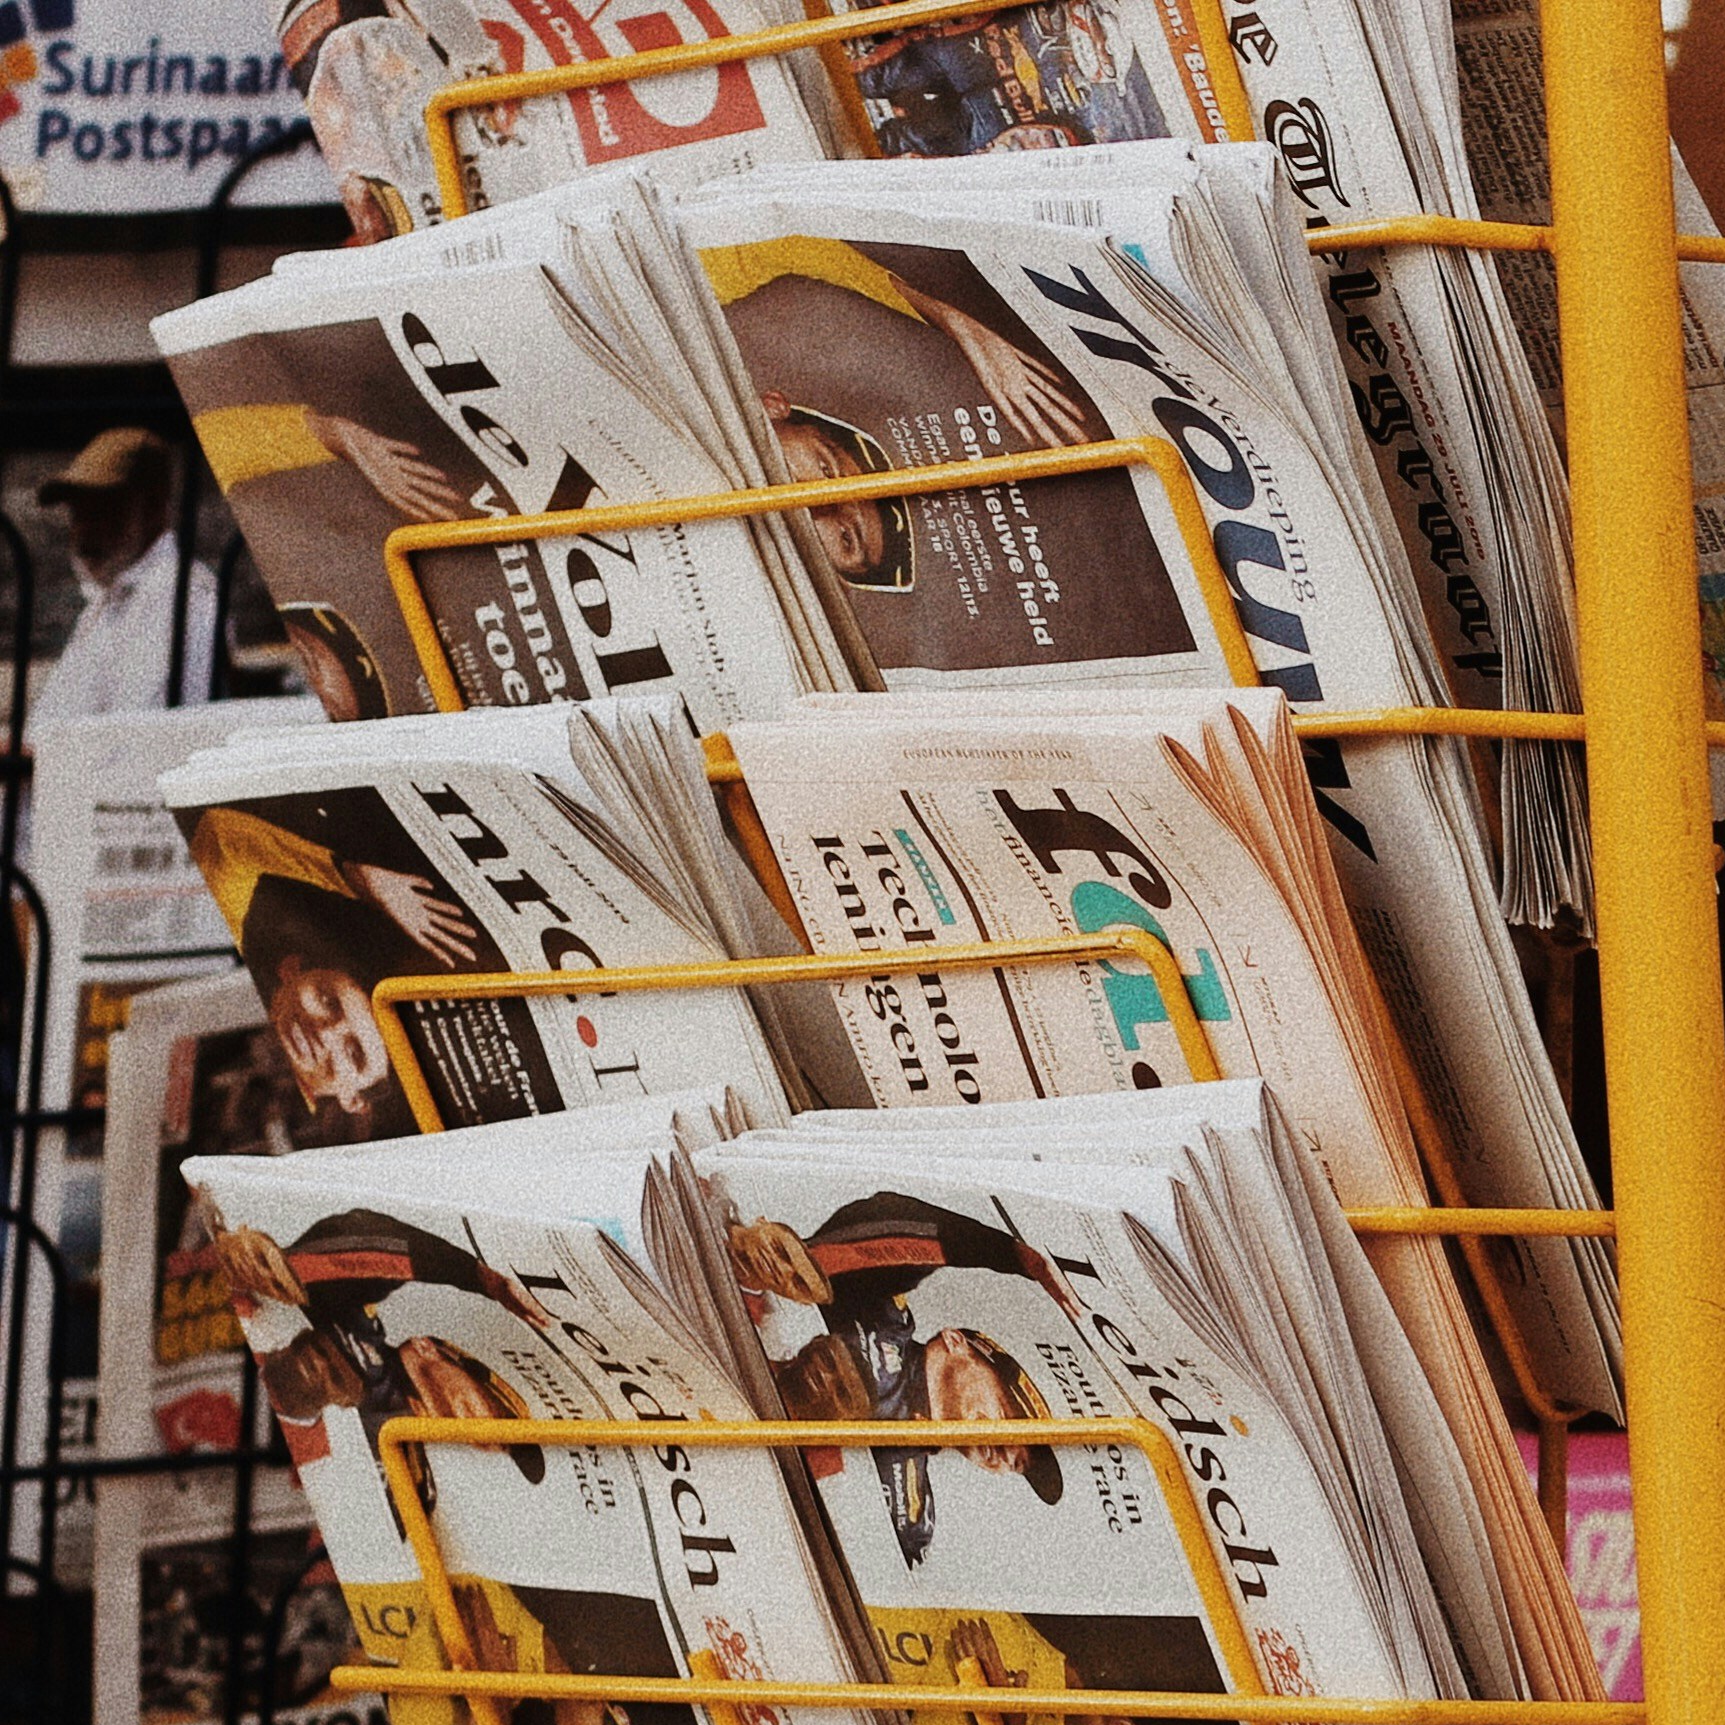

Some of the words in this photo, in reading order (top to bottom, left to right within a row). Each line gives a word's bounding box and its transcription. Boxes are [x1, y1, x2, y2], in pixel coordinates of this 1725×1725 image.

[896, 415, 923, 467] VANDA
[913, 414, 942, 468] winna
[950, 511, 989, 593] Colombia
[975, 402, 1003, 446] De
[994, 451, 1034, 526] our
[1019, 521, 1062, 605] heeft
[1385, 320, 1437, 431] MAANDAG
[1440, 459, 1468, 511] JULI
[543, 443, 674, 695] Vol
[951, 406, 984, 463] een
[980, 485, 1025, 575] ieuwe
[1013, 578, 1054, 649] held
[965, 517, 994, 573] eerste
[460, 1001, 501, 1085] pektakel
[489, 999, 511, 1035] our
[1084, 986, 1131, 1093] dagbla
[501, 1349, 562, 1421] bizarr
[1034, 1341, 1098, 1453] bizare
[1091, 1463, 1125, 1535] race
[1045, 1246, 1280, 1603] Leidsch
[1055, 1343, 1131, 1482] Foutlos
[1119, 1493, 1143, 1525] in
